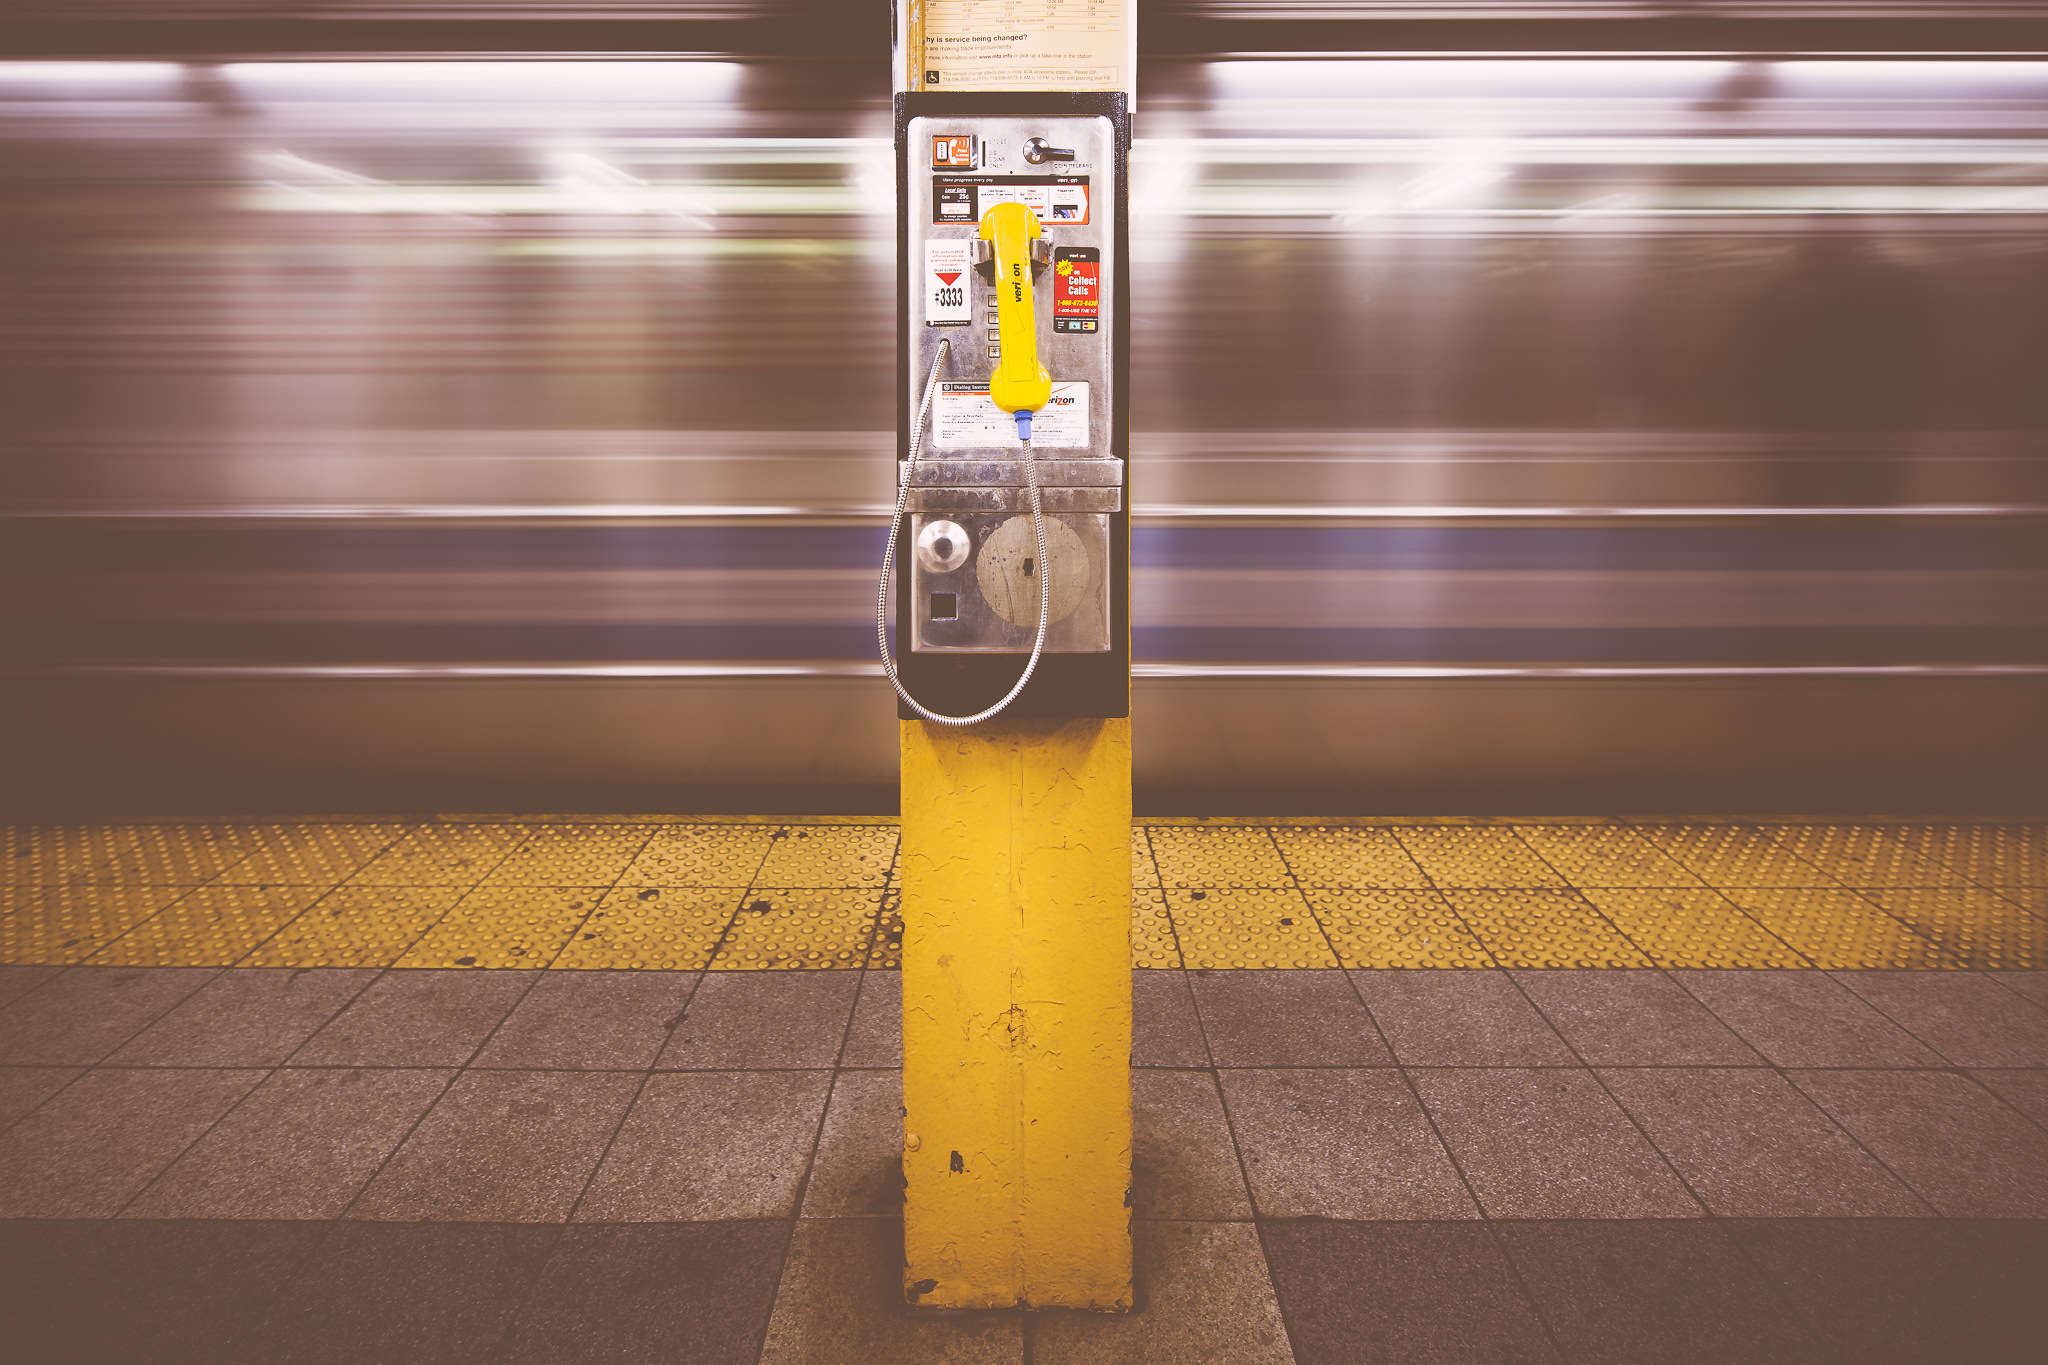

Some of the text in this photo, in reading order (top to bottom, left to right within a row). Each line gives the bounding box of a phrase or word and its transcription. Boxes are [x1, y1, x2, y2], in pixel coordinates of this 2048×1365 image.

[1012, 263, 1022, 302] verizon
[1068, 276, 1097, 286] Collect
[1068, 286, 1089, 295] Calls
[1048, 396, 1074, 405] rizon
